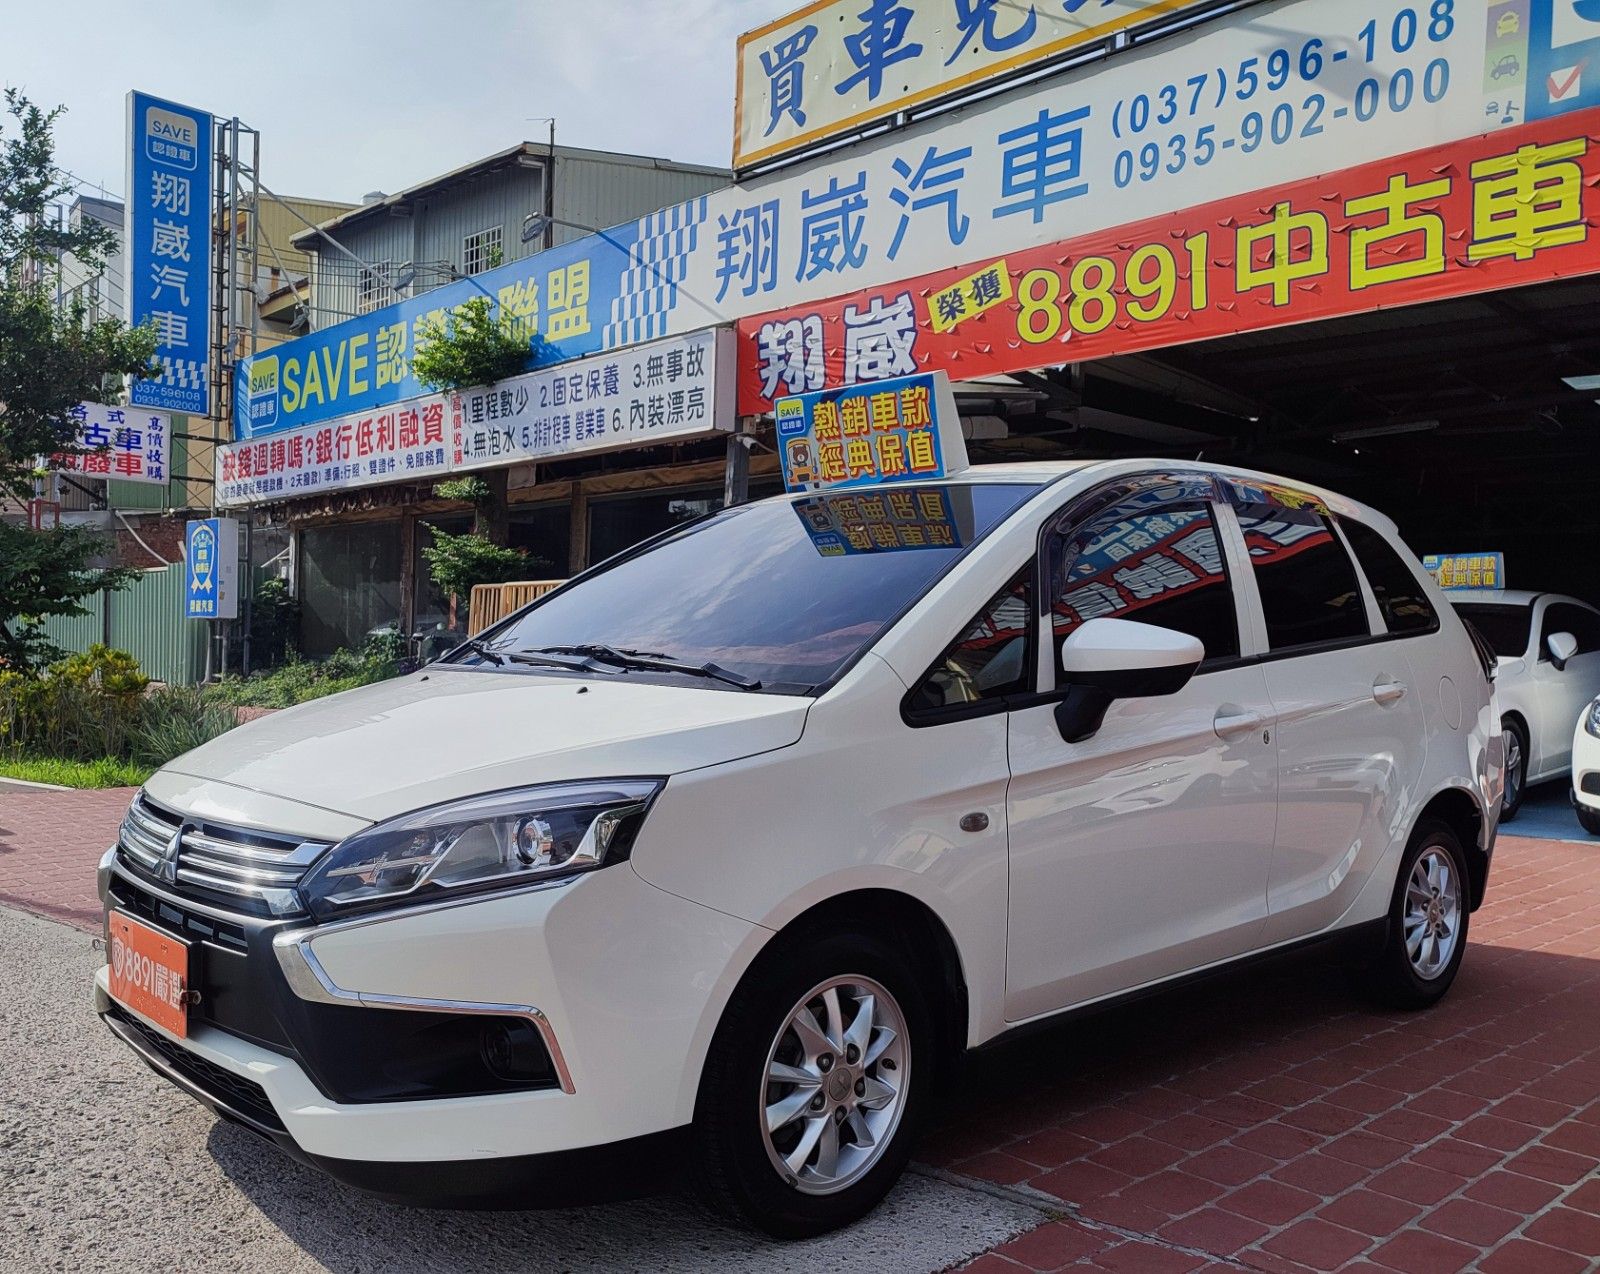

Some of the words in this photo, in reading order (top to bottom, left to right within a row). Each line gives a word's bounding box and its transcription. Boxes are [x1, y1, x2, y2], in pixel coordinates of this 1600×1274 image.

[1112, 0, 1455, 138] (037)596-108
[152, 120, 191, 142] SAVE
[152, 140, 191, 162] 認證車
[1113, 57, 1450, 189] 0935-902-000
[714, 105, 1092, 304] 翔崴汽車
[151, 170, 191, 349] 翔崴汽車
[936, 268, 1002, 325] 榮獲
[758, 290, 919, 400] 翔崴
[135, 394, 201, 412] 0935-902000
[251, 372, 275, 393] SAVE
[540, 363, 619, 408] 2.固定保養
[633, 343, 705, 389] 3.無事故
[780, 407, 801, 418] SAVE
[813, 385, 931, 441] 熱銷車款
[463, 424, 516, 459] 4.無泡水
[818, 430, 938, 481] 經典保值
